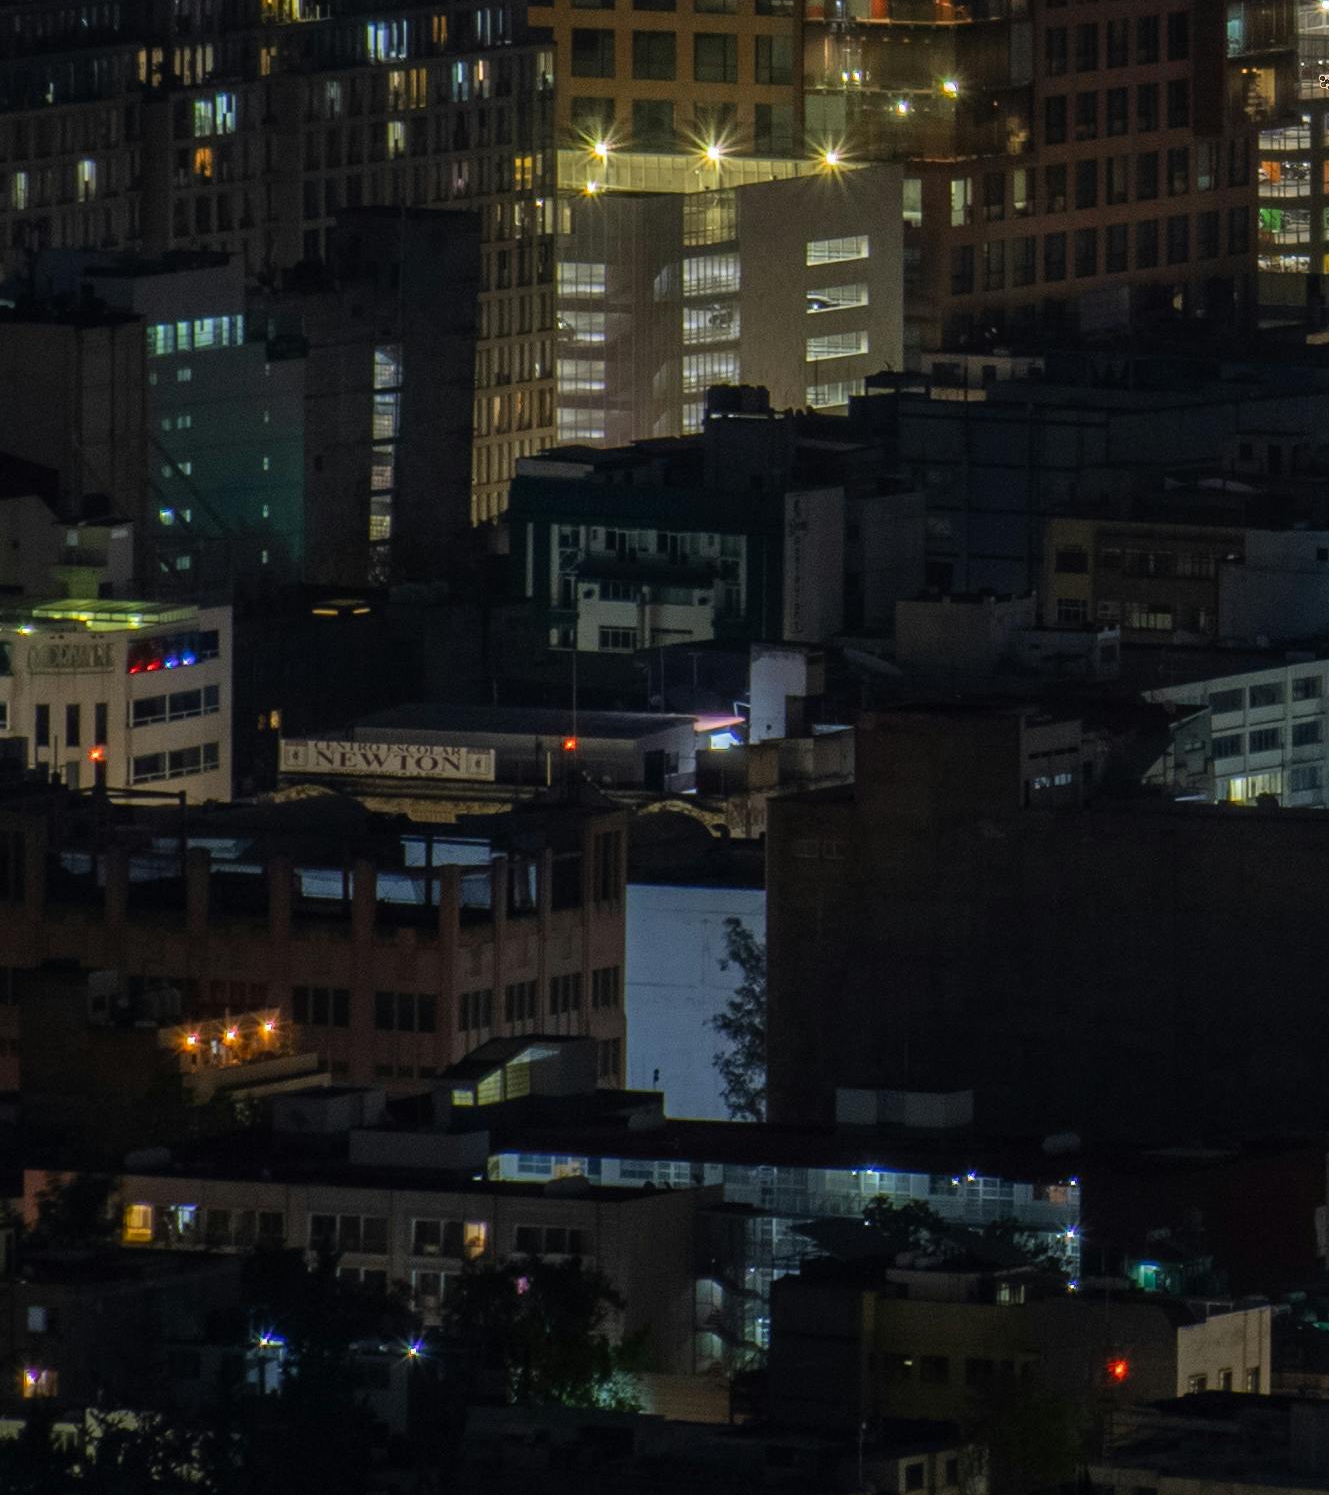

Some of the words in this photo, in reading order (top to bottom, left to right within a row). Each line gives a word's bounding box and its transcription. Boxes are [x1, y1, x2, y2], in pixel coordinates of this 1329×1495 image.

[314, 741, 380, 753] CENTRO
[387, 743, 462, 756] ESCOLAR
[315, 751, 462, 772] NEWTON
